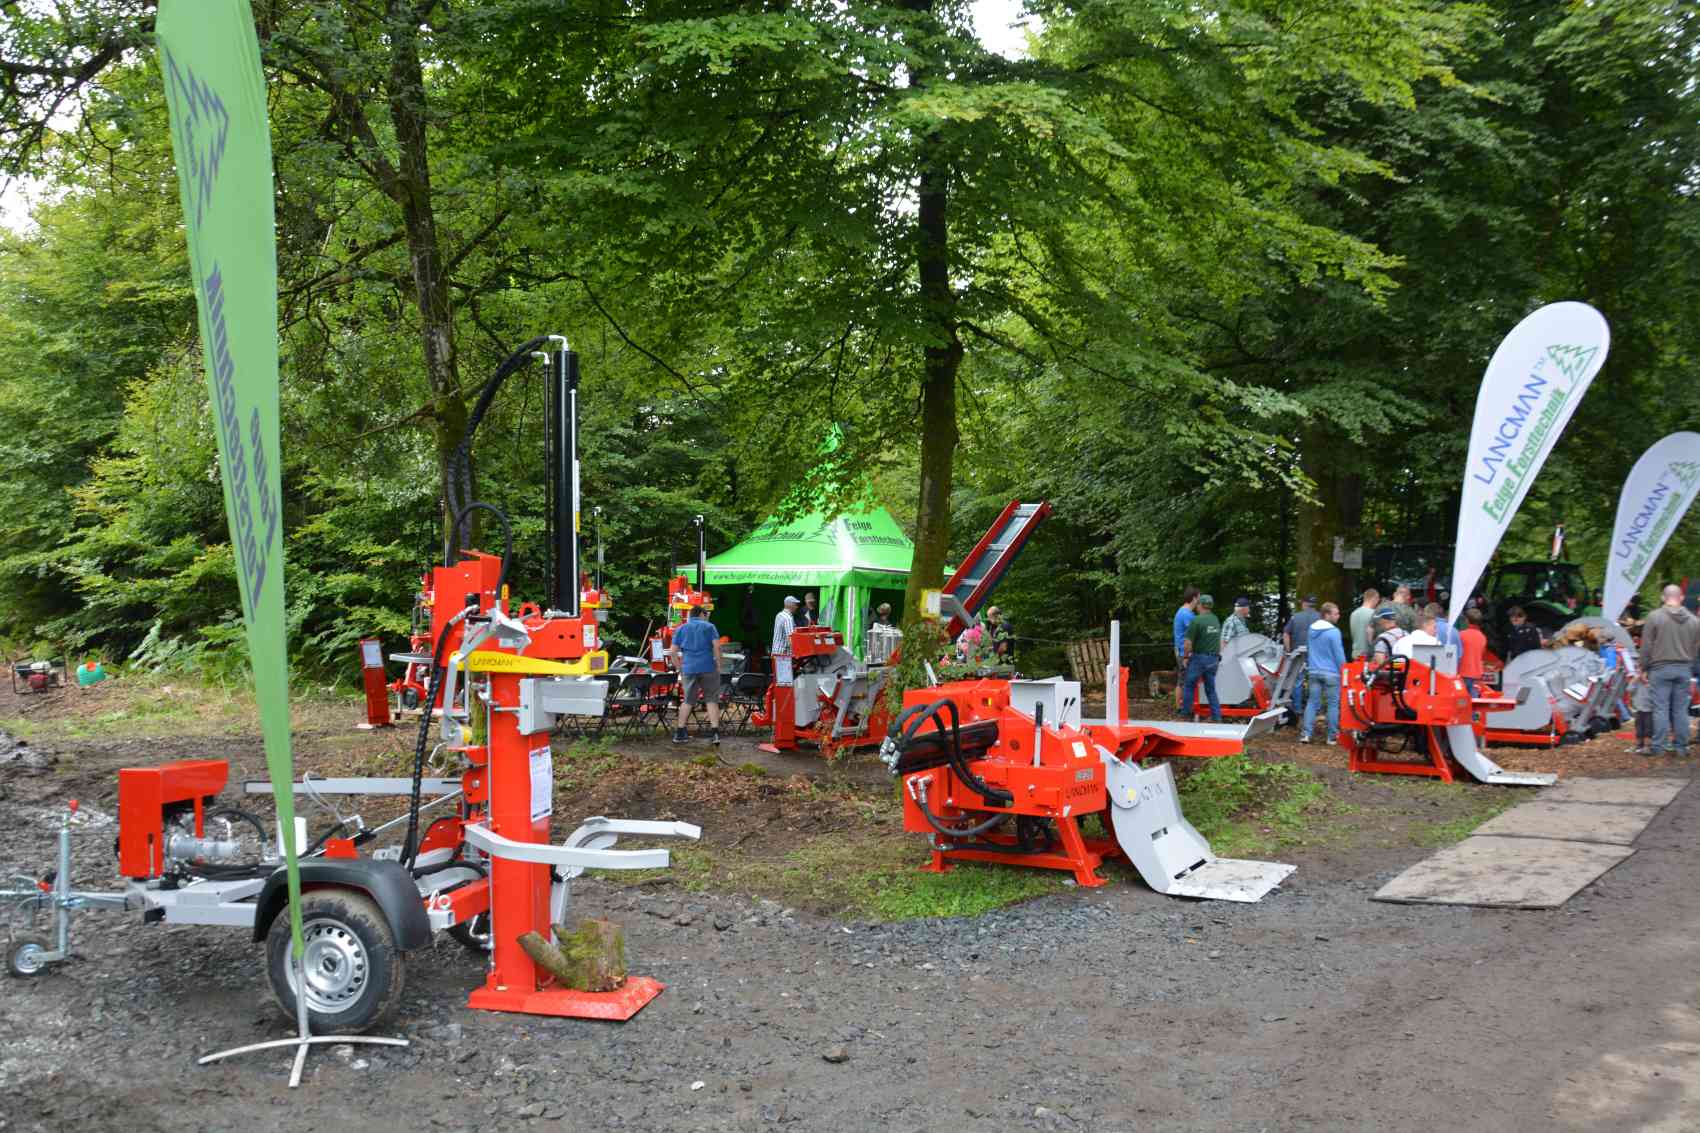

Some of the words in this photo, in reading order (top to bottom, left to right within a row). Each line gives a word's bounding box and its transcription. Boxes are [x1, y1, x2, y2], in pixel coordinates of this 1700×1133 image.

[1473, 374, 1548, 485] LANCMAN
[1482, 476, 1516, 521] Feige
[1506, 386, 1566, 478] Forsttechnik
[1615, 483, 1670, 559] LANCMAN
